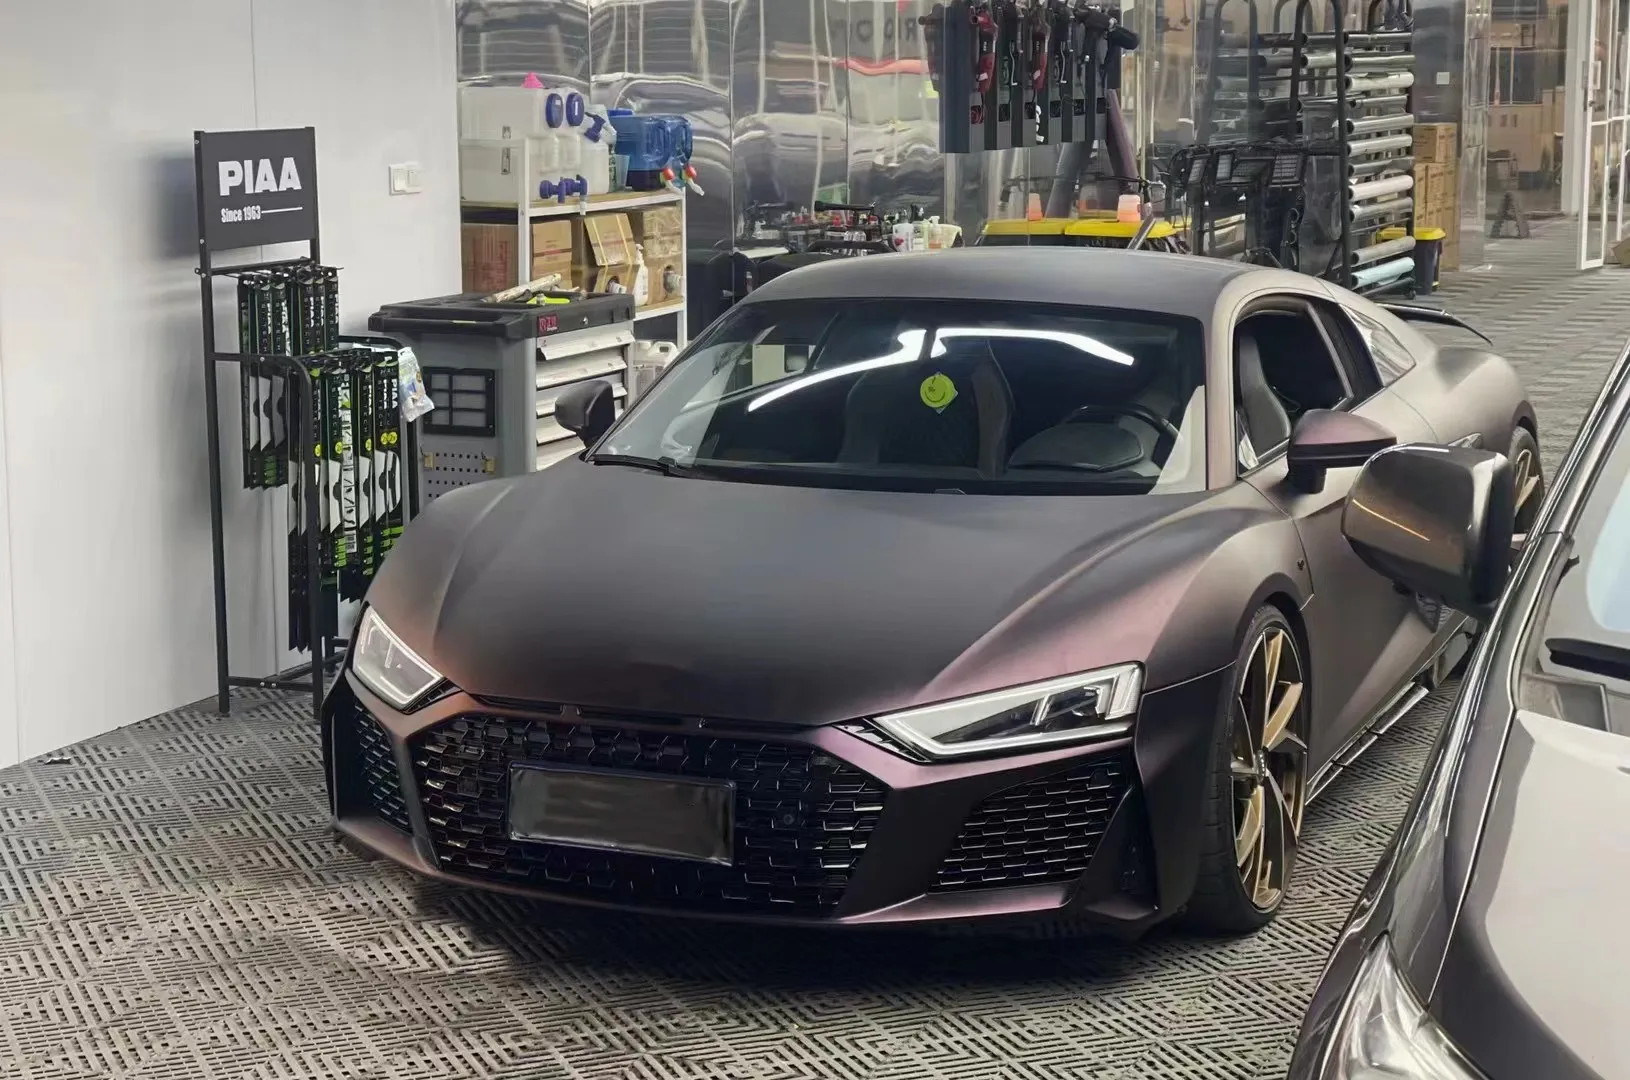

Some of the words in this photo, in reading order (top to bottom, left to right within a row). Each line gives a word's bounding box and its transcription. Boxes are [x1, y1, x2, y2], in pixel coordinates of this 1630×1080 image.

[218, 157, 302, 196] PIAA
[221, 207, 243, 223] Since
[243, 205, 261, 222] 1963
